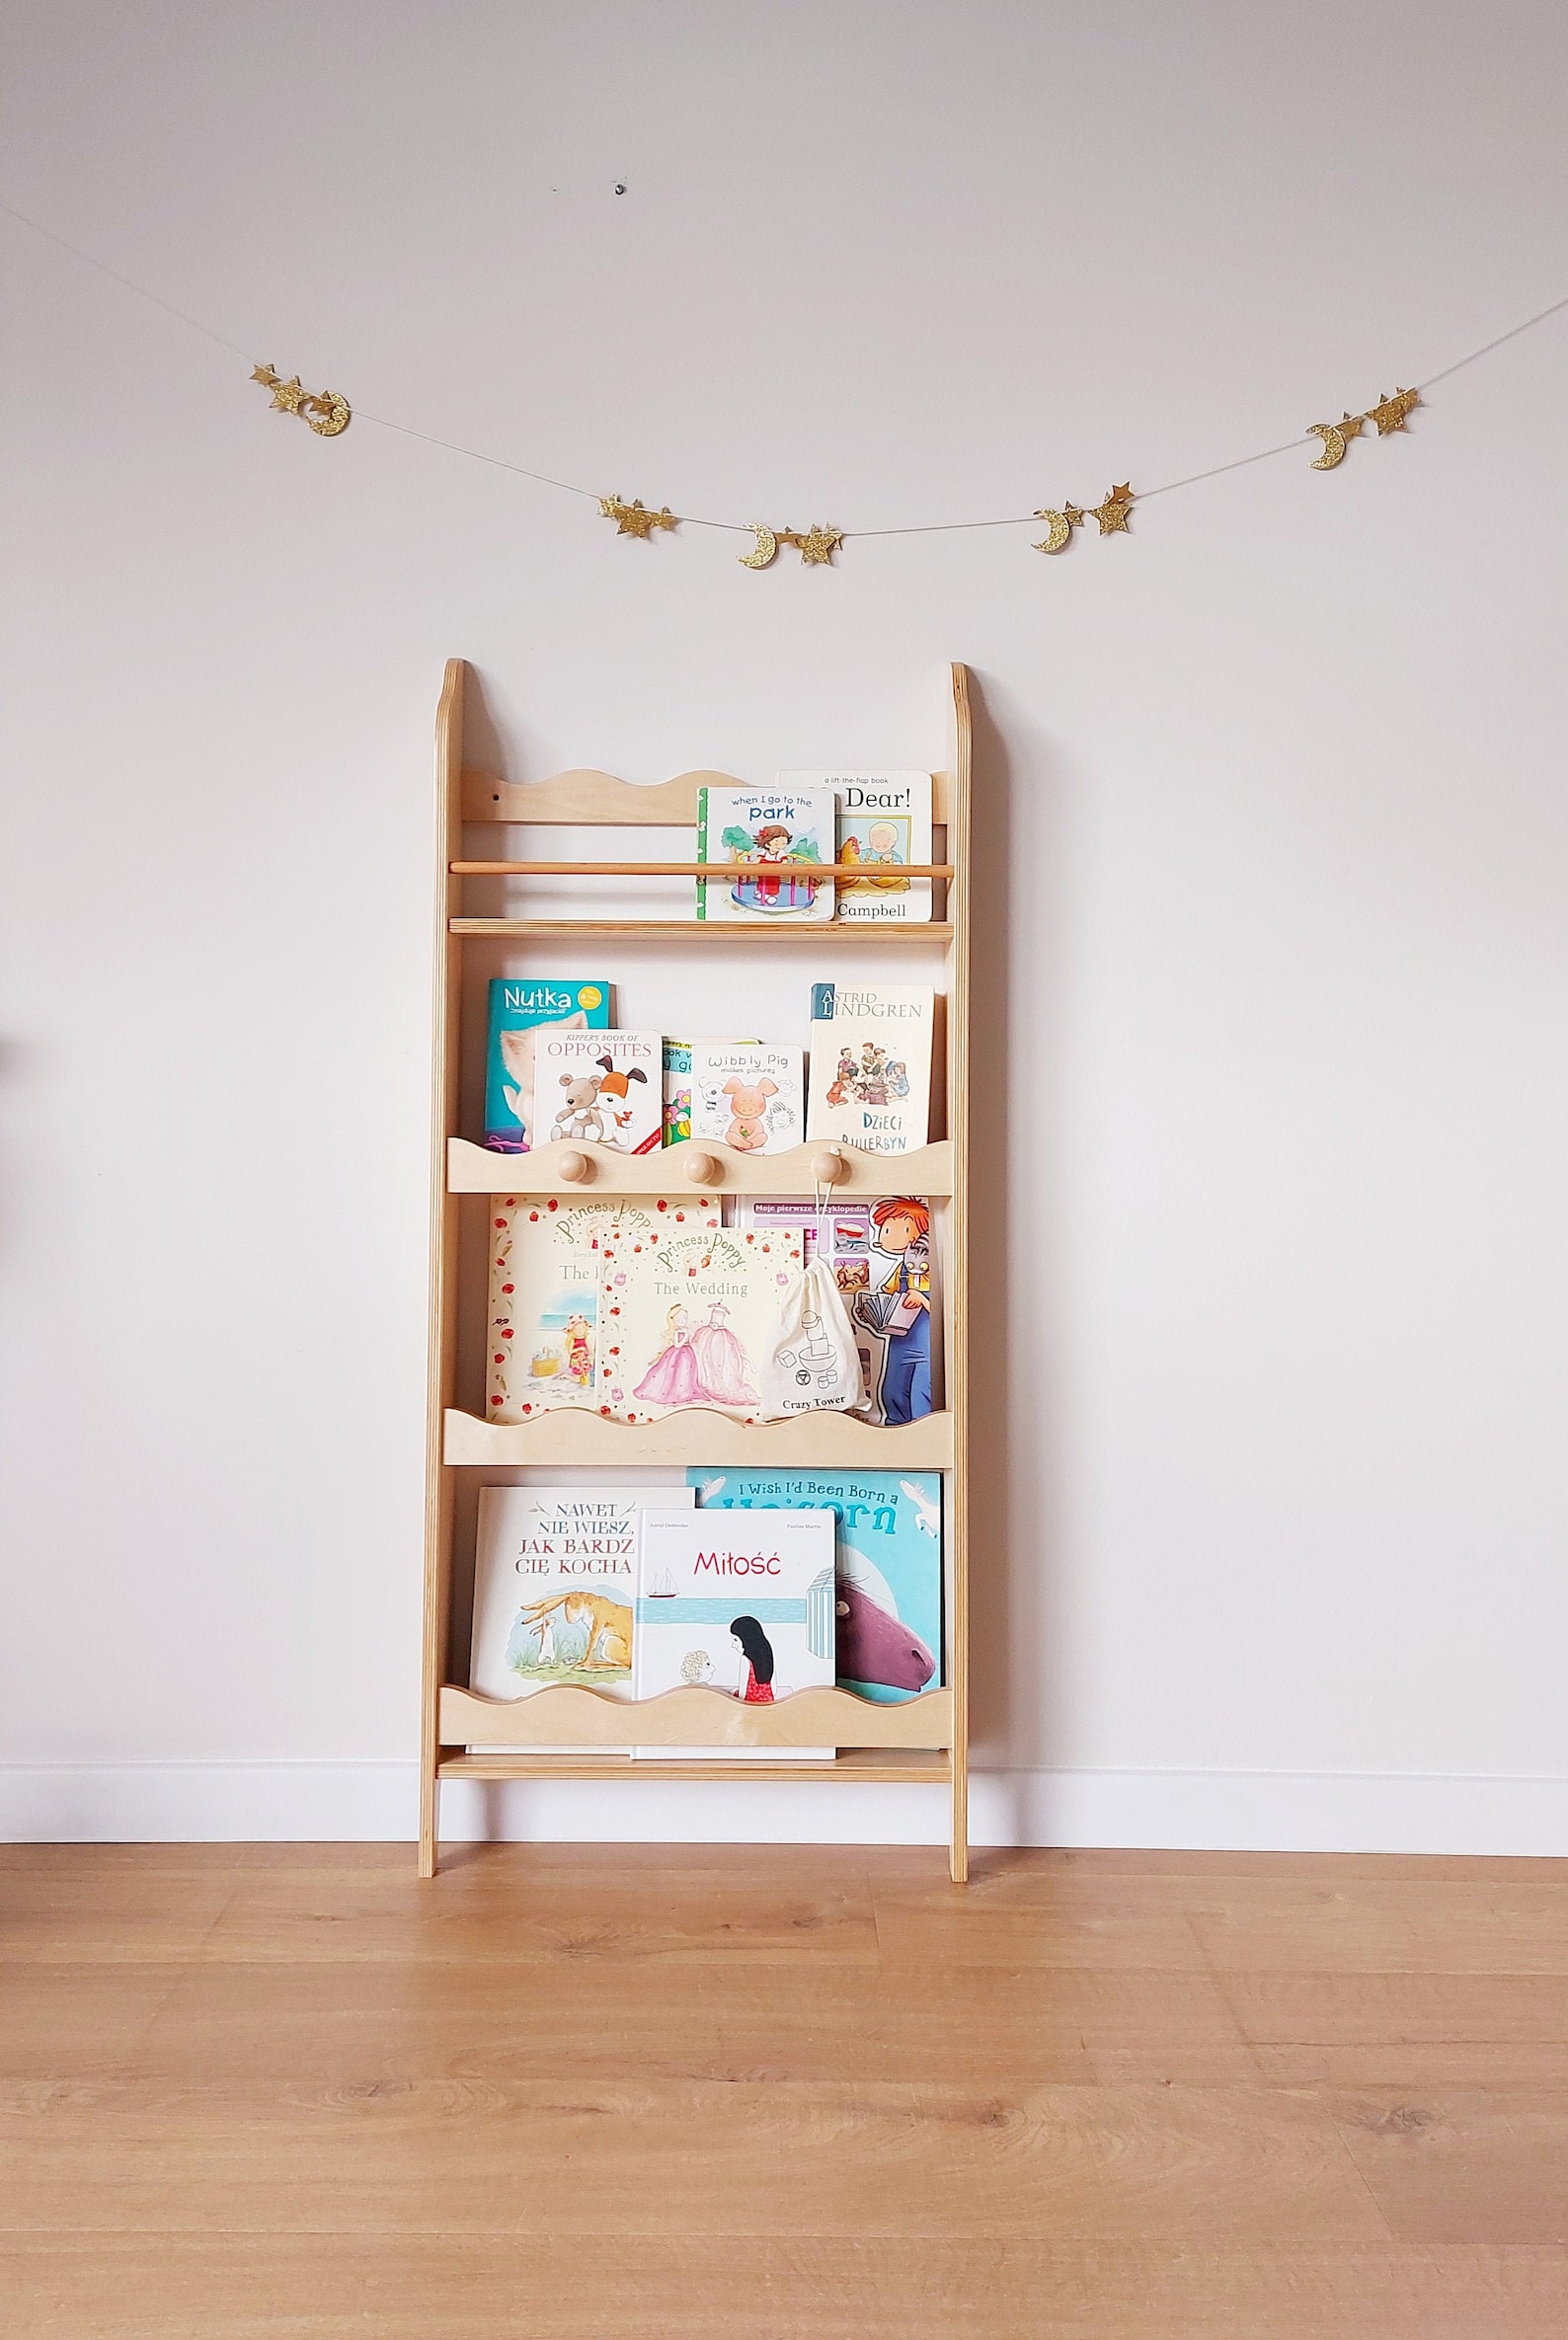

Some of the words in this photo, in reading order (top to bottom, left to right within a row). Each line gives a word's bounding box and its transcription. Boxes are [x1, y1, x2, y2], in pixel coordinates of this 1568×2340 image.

[731, 796, 759, 807] when
[760, 795, 767, 804] I
[767, 795, 781, 807] go
[783, 795, 794, 806] to
[796, 796, 813, 809] the
[845, 788, 911, 809] Dear!
[748, 805, 796, 821] park
[836, 902, 906, 919] Campbell
[504, 986, 572, 1009] Nutka
[822, 989, 877, 1004] ASTRID
[823, 1001, 923, 1018] LINDGREN
[547, 1042, 652, 1057] OPPOSITES
[708, 1054, 761, 1068] Wibbly
[767, 1053, 788, 1069] Pig
[755, 1205, 774, 1214] Moje
[556, 1202, 616, 1245] Princess
[612, 1199, 652, 1228] Popp
[657, 1234, 709, 1274] Princess
[705, 1232, 746, 1269] Poppy
[559, 1265, 590, 1280] The
[654, 1282, 681, 1295] The
[686, 1282, 748, 1298] Wedding
[782, 1399, 812, 1410] Crazy
[813, 1395, 846, 1408] Tower
[740, 1484, 745, 1496] I
[747, 1482, 782, 1496] Wish
[785, 1481, 803, 1495] I'd
[806, 1481, 845, 1498] Been
[847, 1484, 887, 1503] Born
[890, 1493, 900, 1506] a
[555, 1503, 618, 1518] NAWET
[537, 1521, 570, 1535] NIE
[574, 1521, 635, 1536] WIESZ,
[517, 1538, 556, 1556] JAK
[562, 1538, 635, 1555] BARDZ
[514, 1558, 551, 1577] CIĘ
[557, 1558, 633, 1575] KOCHA
[693, 1550, 782, 1577] Miłość
